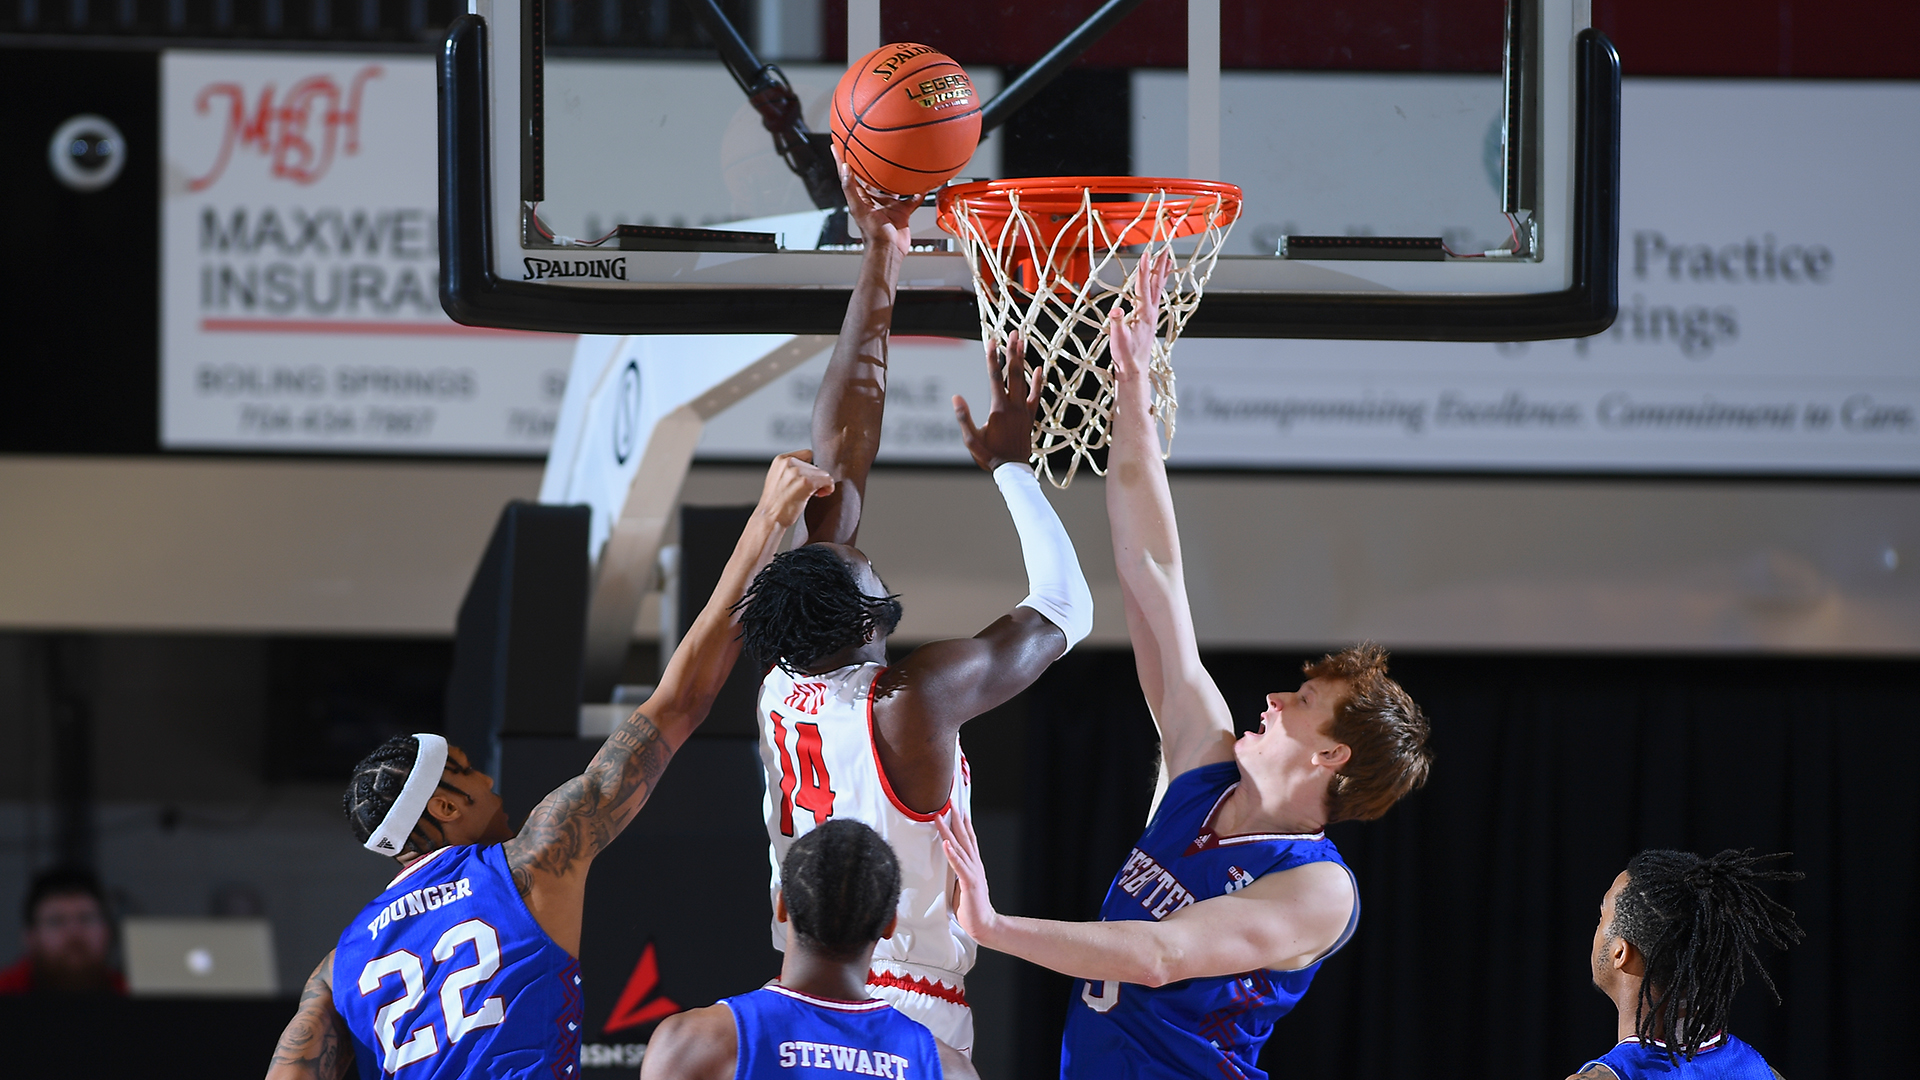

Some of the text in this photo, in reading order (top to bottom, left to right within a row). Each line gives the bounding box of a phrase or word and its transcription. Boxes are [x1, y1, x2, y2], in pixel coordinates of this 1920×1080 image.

[905, 75, 970, 100] LEGACY
[200, 206, 439, 256] MAXWE
[523, 257, 626, 281] SPALDING
[1630, 229, 1835, 285] Practice
[200, 264, 440, 316] INSURA
[197, 364, 478, 401] BOILING SPRINGS
[1597, 391, 1797, 430] Commitment
[1802, 398, 1835, 431] to
[769, 710, 836, 837] 14
[1227, 865, 1244, 881] BIG
[367, 877, 473, 941] YOUNGER
[357, 918, 506, 1076] 22
[779, 1040, 909, 1080] STEWART
